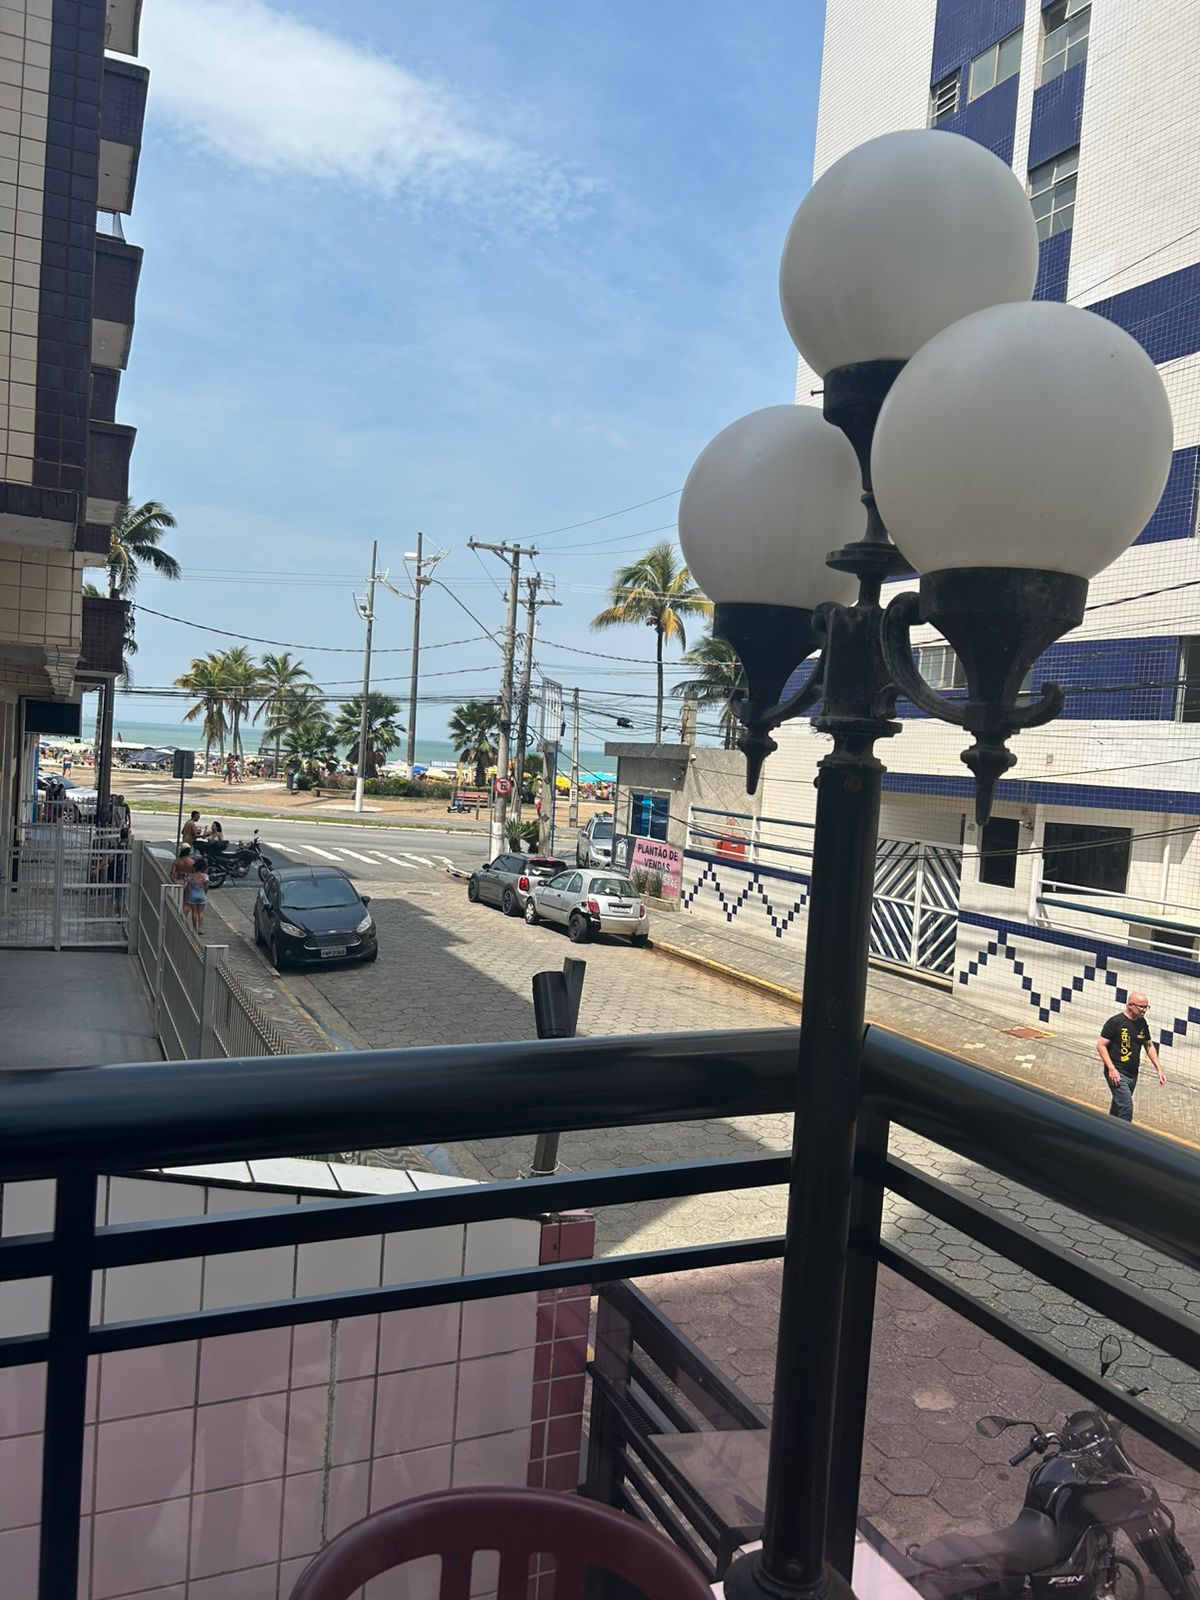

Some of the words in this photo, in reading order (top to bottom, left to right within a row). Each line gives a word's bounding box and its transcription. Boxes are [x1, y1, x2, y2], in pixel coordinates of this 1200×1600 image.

[637, 843, 668, 859] PLANTÃO
[669, 850, 679, 861] DE
[644, 857, 671, 873] VENDAS
[1048, 1575, 1084, 1585] FAN
